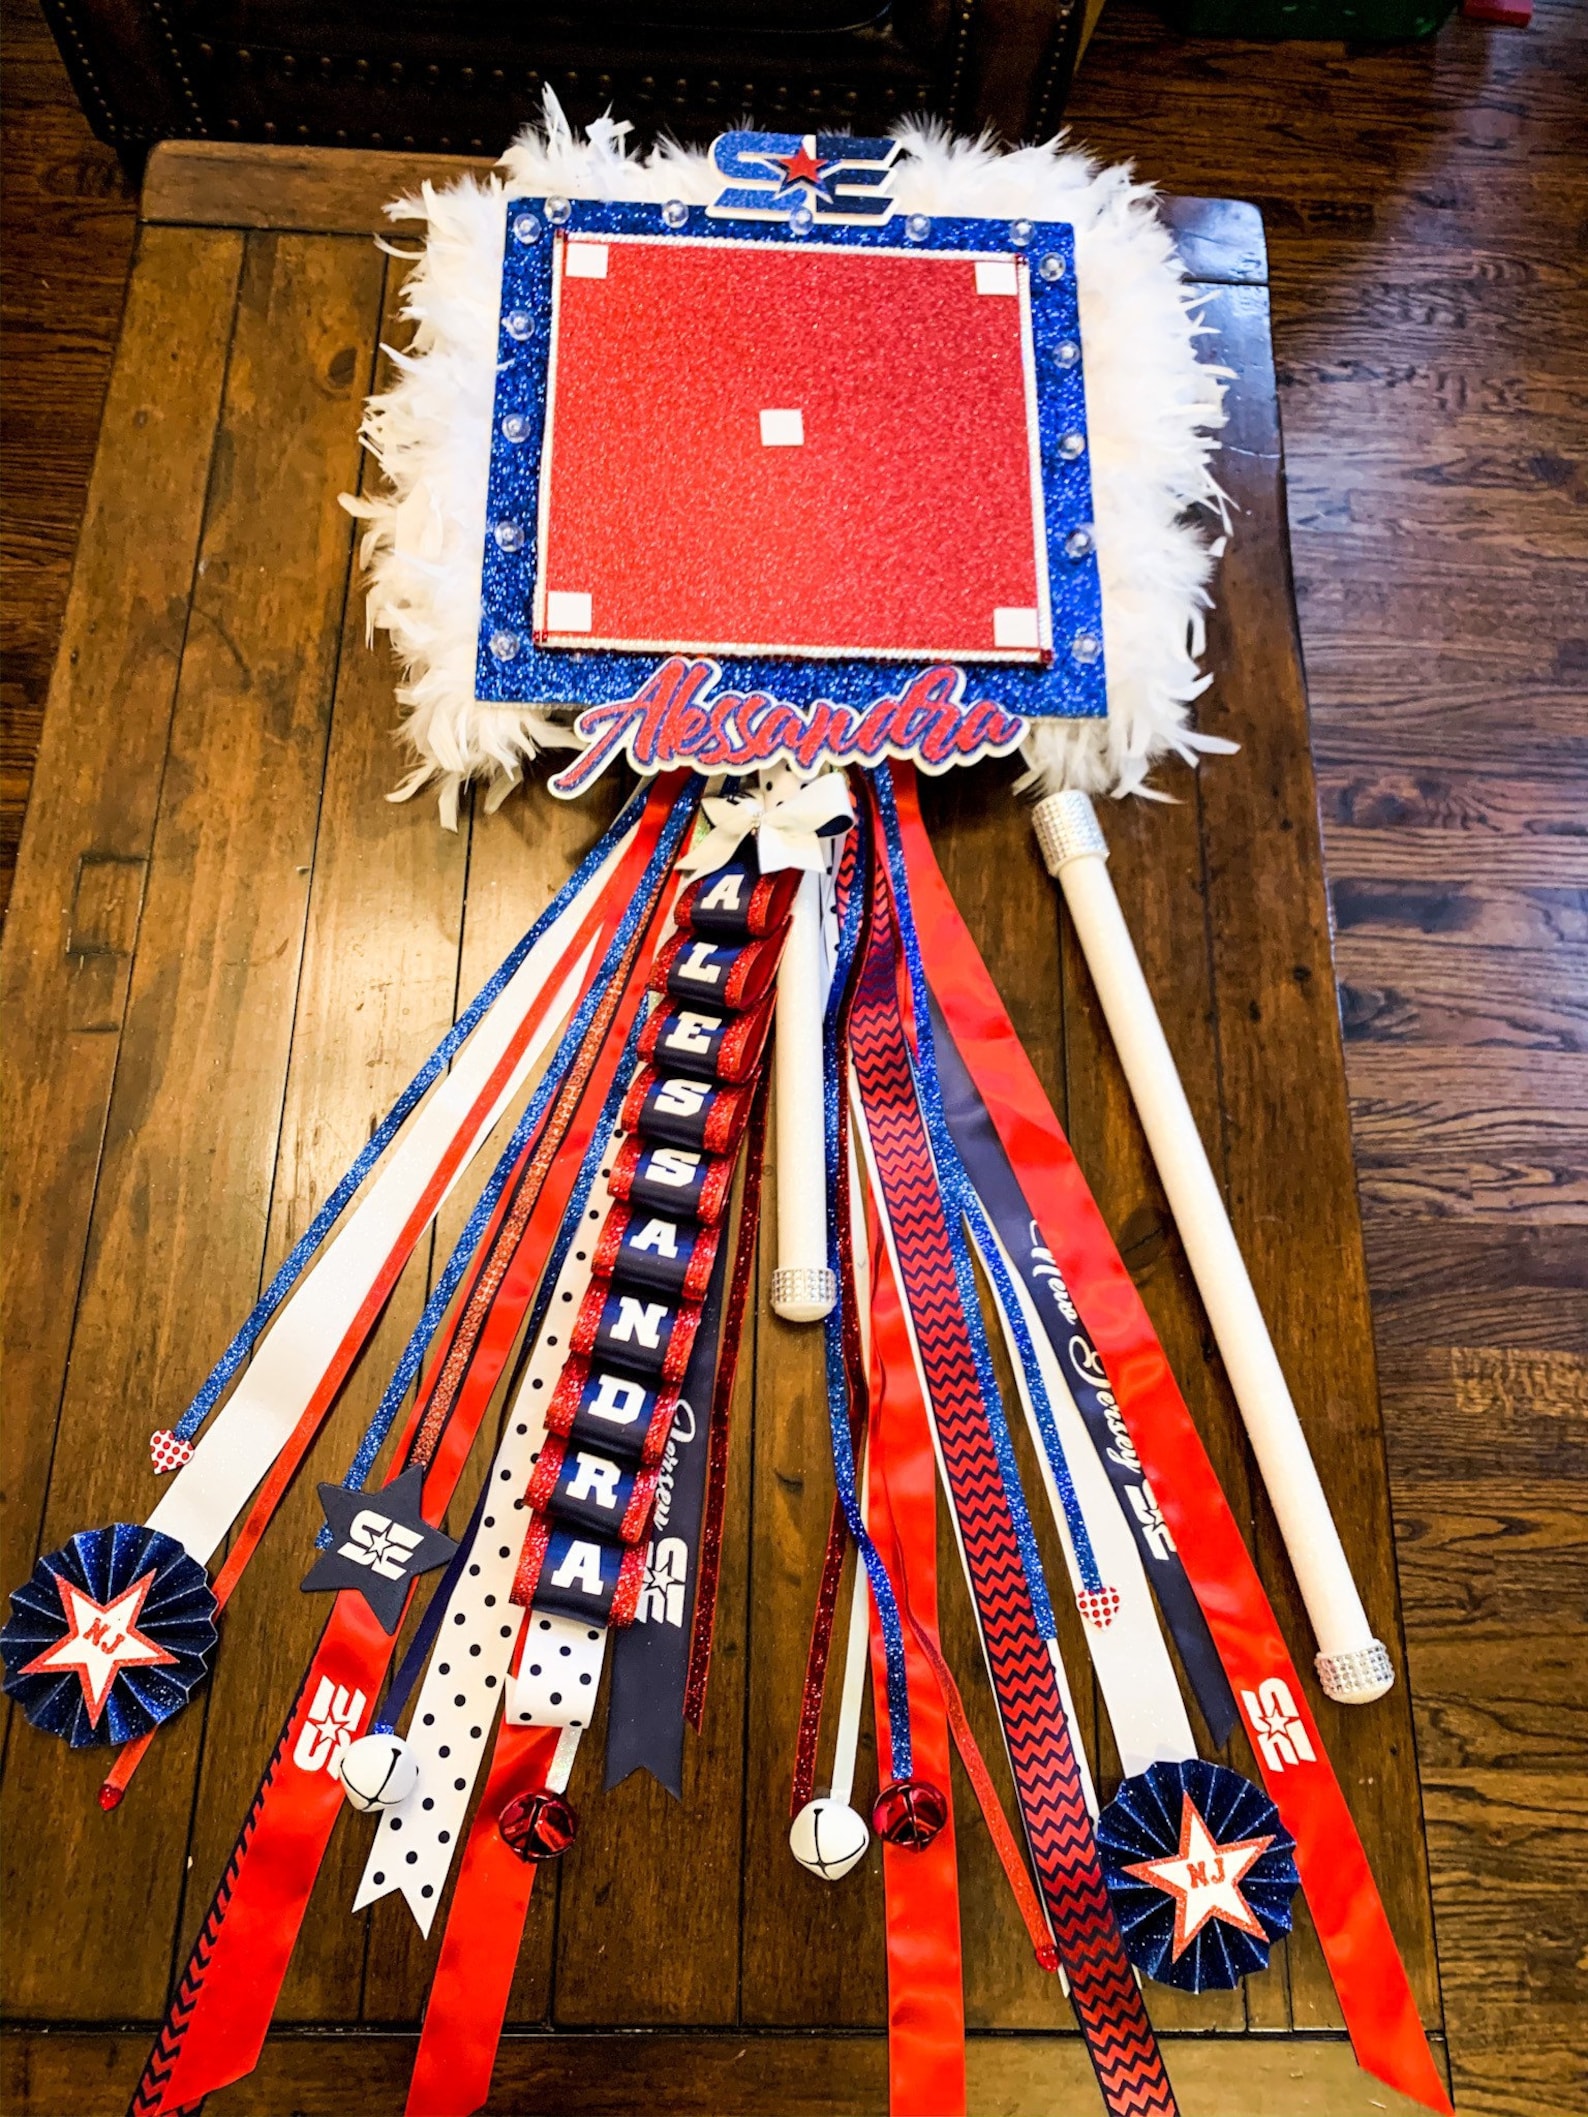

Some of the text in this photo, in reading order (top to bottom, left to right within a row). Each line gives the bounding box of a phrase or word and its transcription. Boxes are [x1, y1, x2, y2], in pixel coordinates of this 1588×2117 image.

[550, 658, 1026, 795] Alessandra
[337, 1509, 424, 1582] SE
[83, 1616, 124, 1654] NJ
[1241, 1676, 1316, 1773] SE
[1186, 1857, 1227, 1888] NJ
